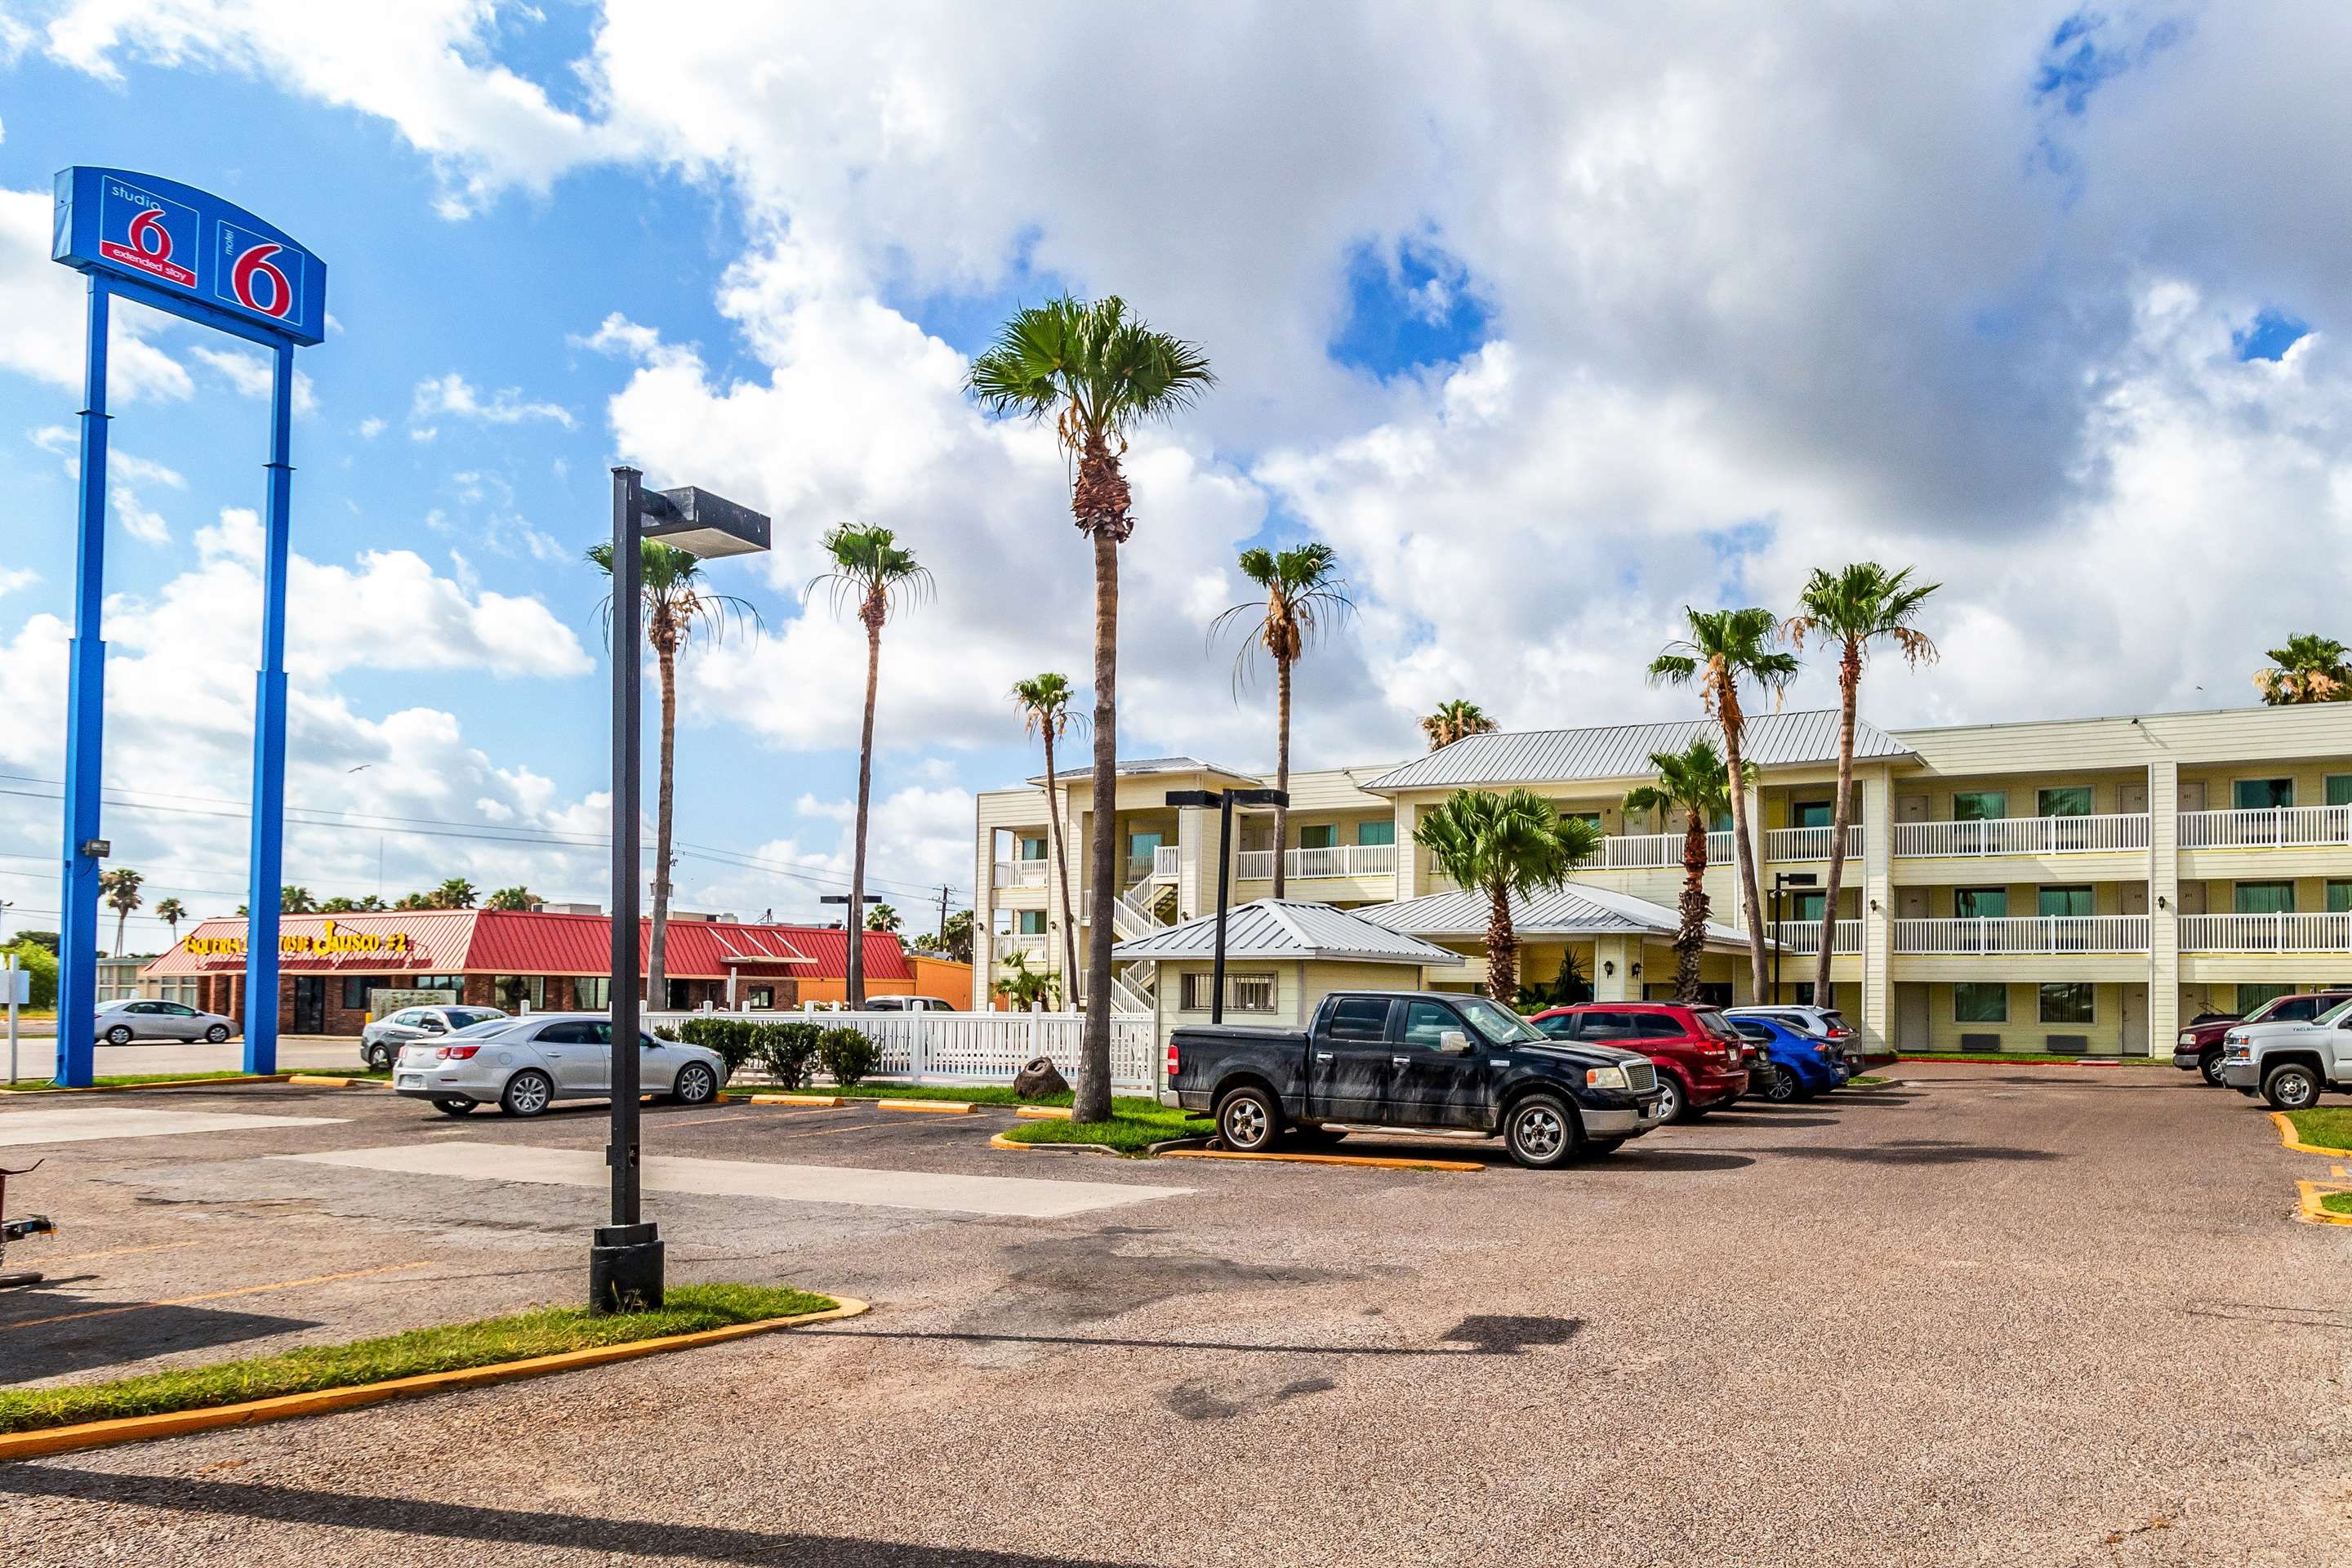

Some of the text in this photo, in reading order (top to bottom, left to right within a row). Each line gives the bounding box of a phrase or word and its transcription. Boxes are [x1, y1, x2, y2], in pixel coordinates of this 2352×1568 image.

[112, 187, 161, 210] studio
[128, 209, 173, 261] 6
[113, 249, 186, 282] extended stay
[224, 229, 292, 318] motel 6
[184, 935, 240, 956] TAQUERIA
[313, 920, 380, 956] JALISCO
[386, 933, 406, 952] #2
